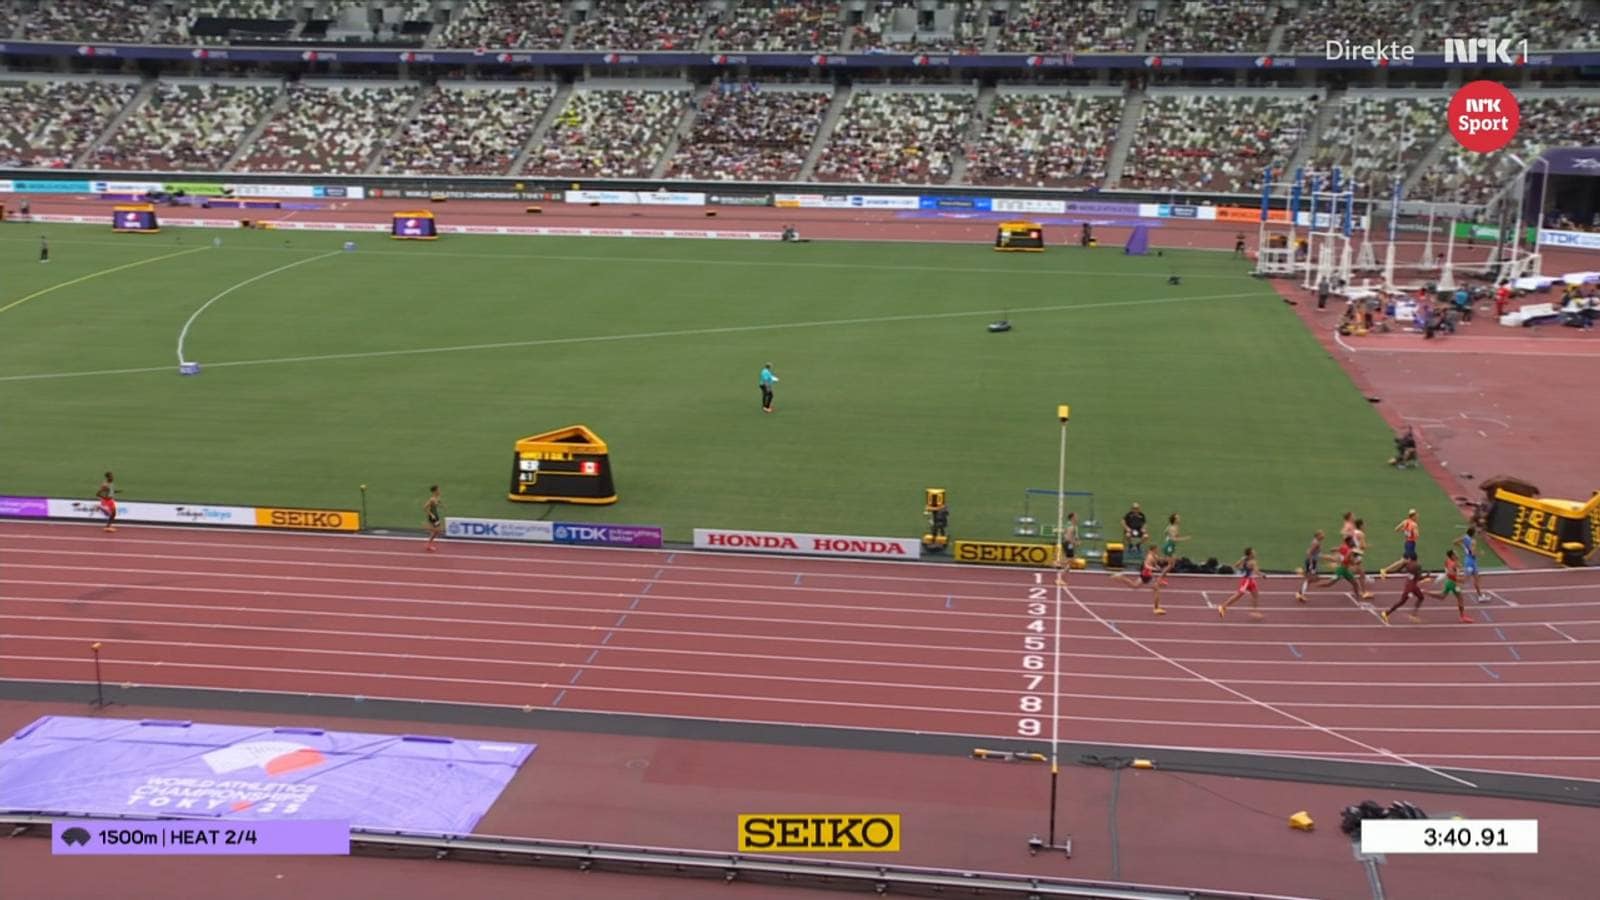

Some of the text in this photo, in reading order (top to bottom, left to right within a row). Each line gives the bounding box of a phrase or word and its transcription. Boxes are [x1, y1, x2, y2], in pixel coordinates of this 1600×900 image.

[271, 510, 343, 528] SEIKO
[460, 522, 498, 535] TDK
[567, 526, 608, 540] TDK
[708, 534, 905, 555] HONDA HONDA
[960, 543, 1048, 563] SEIKO
[1034, 573, 1043, 584] 1
[1029, 587, 1047, 600] 2
[1027, 603, 1047, 615] 3
[1026, 620, 1045, 633] 4
[1024, 636, 1045, 650] 5
[1023, 656, 1044, 670] 6
[1022, 675, 1044, 690] 7
[1019, 696, 1042, 712] 8
[1017, 719, 1041, 736] 9
[147, 777, 319, 793] WORLD ATHLETICS
[134, 785, 308, 803] CHAMPIONSHIPS
